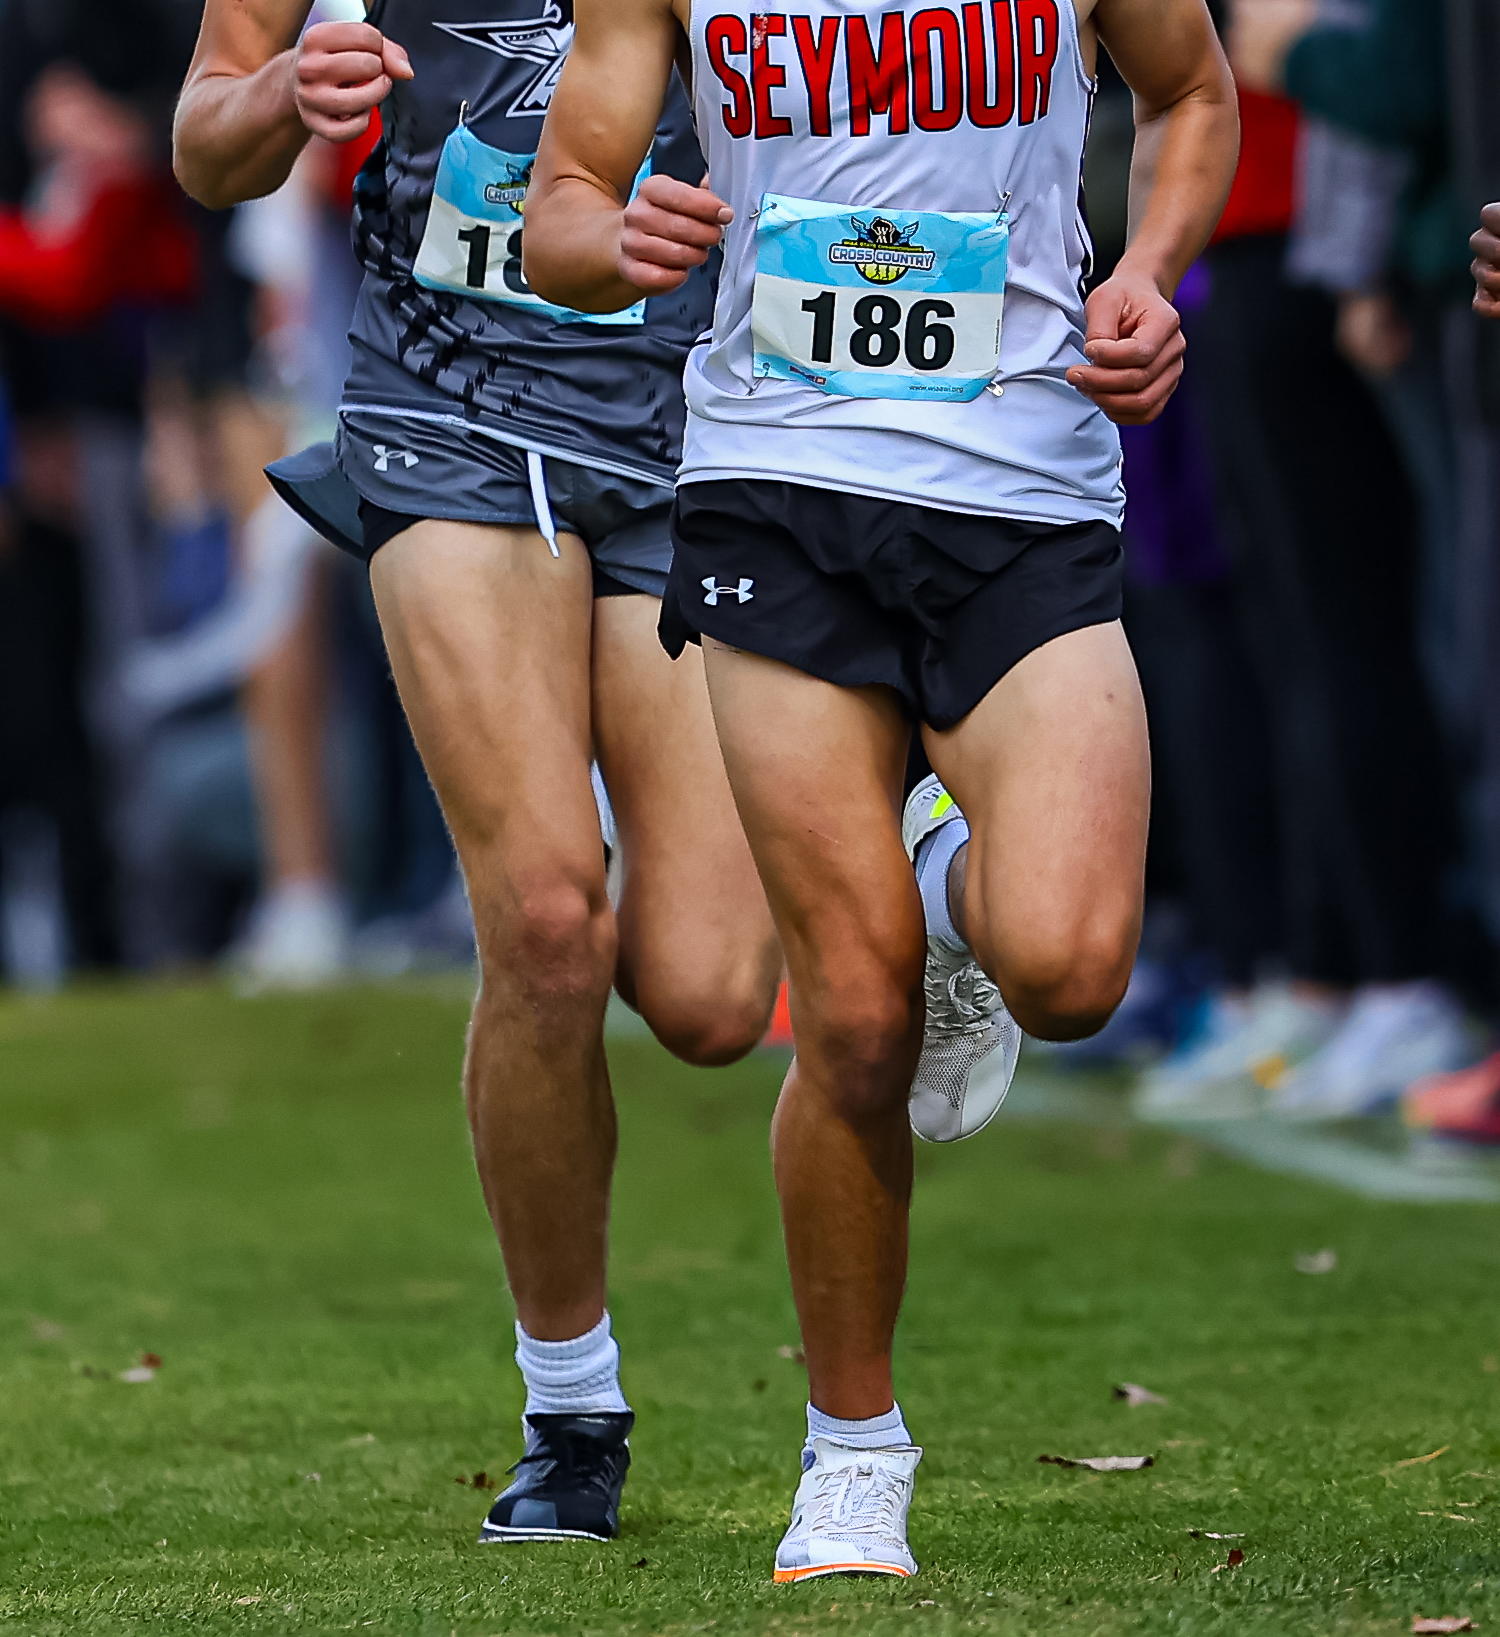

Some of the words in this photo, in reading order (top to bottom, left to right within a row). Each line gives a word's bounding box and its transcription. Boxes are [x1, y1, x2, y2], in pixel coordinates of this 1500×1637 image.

[832, 248, 873, 261] CROSS
[875, 251, 933, 267] COUNTRY
[801, 291, 956, 371] 186
